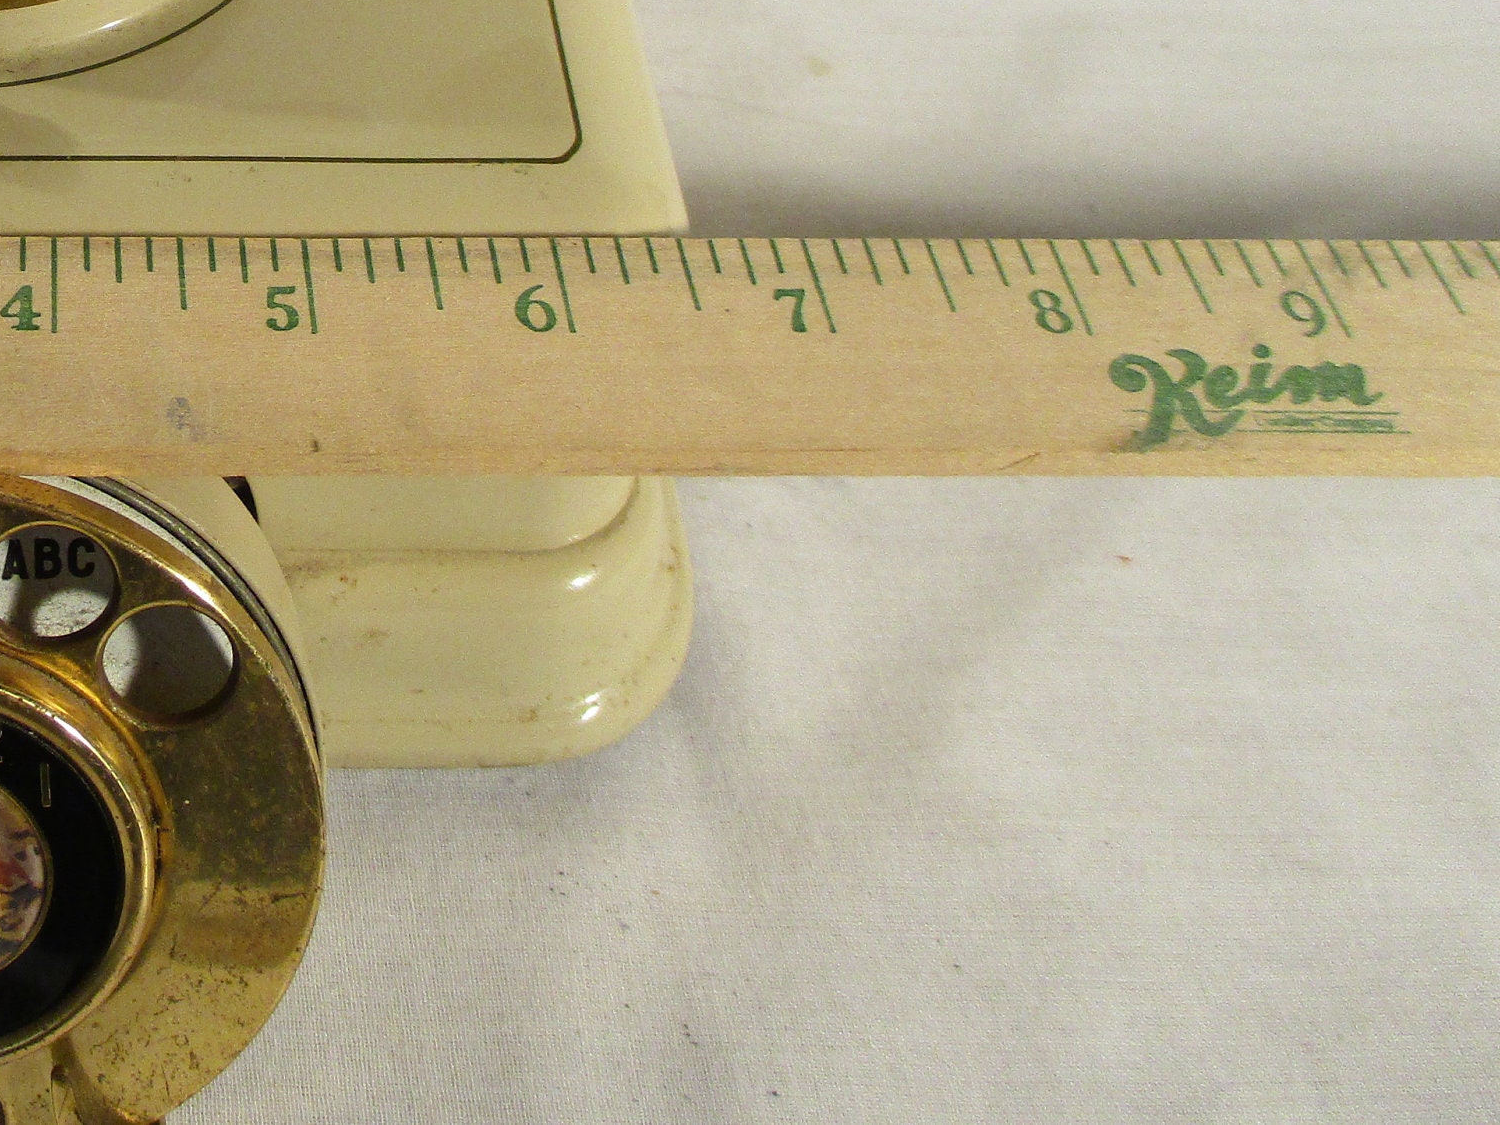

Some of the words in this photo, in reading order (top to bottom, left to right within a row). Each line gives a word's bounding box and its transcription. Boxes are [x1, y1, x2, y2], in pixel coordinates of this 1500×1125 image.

[0, 285, 41, 331] 4
[267, 286, 299, 331] 5
[514, 285, 557, 332] 6
[773, 288, 808, 333] 7
[1029, 290, 1073, 334] 8
[1280, 291, 1326, 337] 9
[1, 536, 96, 580] ABC
